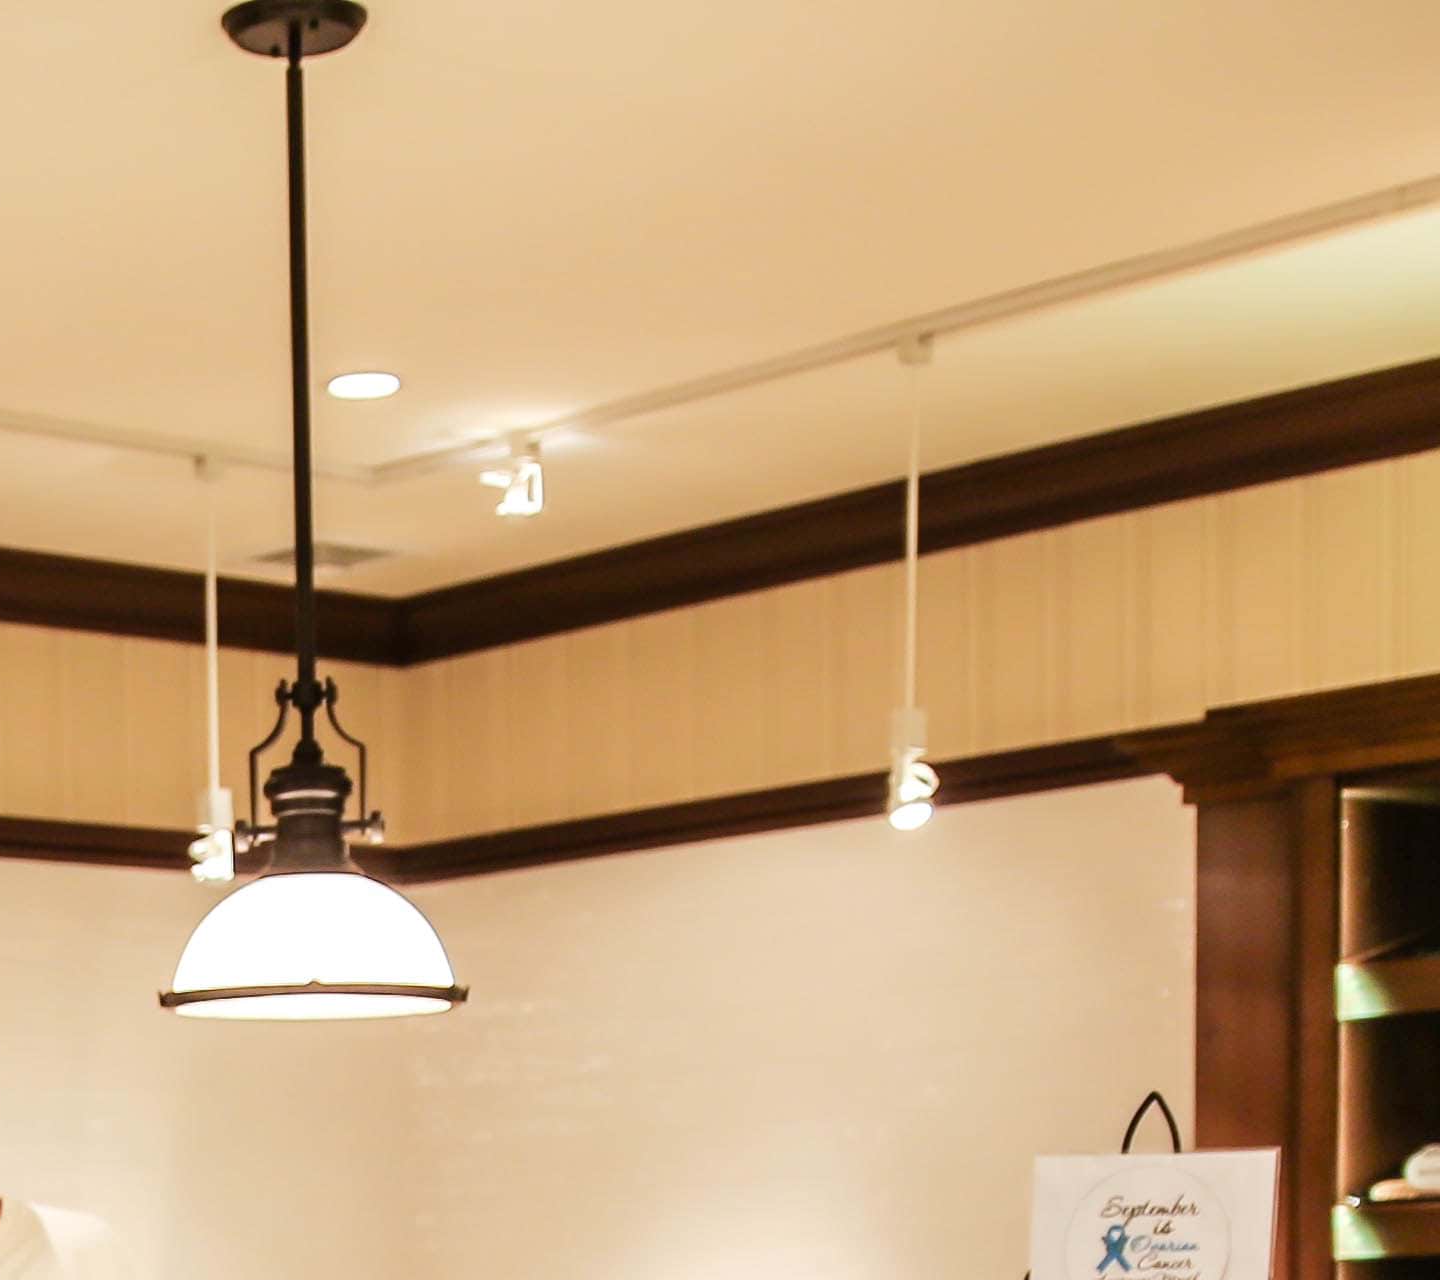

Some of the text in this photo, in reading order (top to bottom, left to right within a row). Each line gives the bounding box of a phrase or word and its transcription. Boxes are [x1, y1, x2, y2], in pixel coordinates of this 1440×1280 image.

[1100, 1194, 1199, 1228] September
[1153, 1220, 1173, 1235] is
[1130, 1235, 1198, 1252] Ovarian
[1137, 1252, 1192, 1271] Cancer
